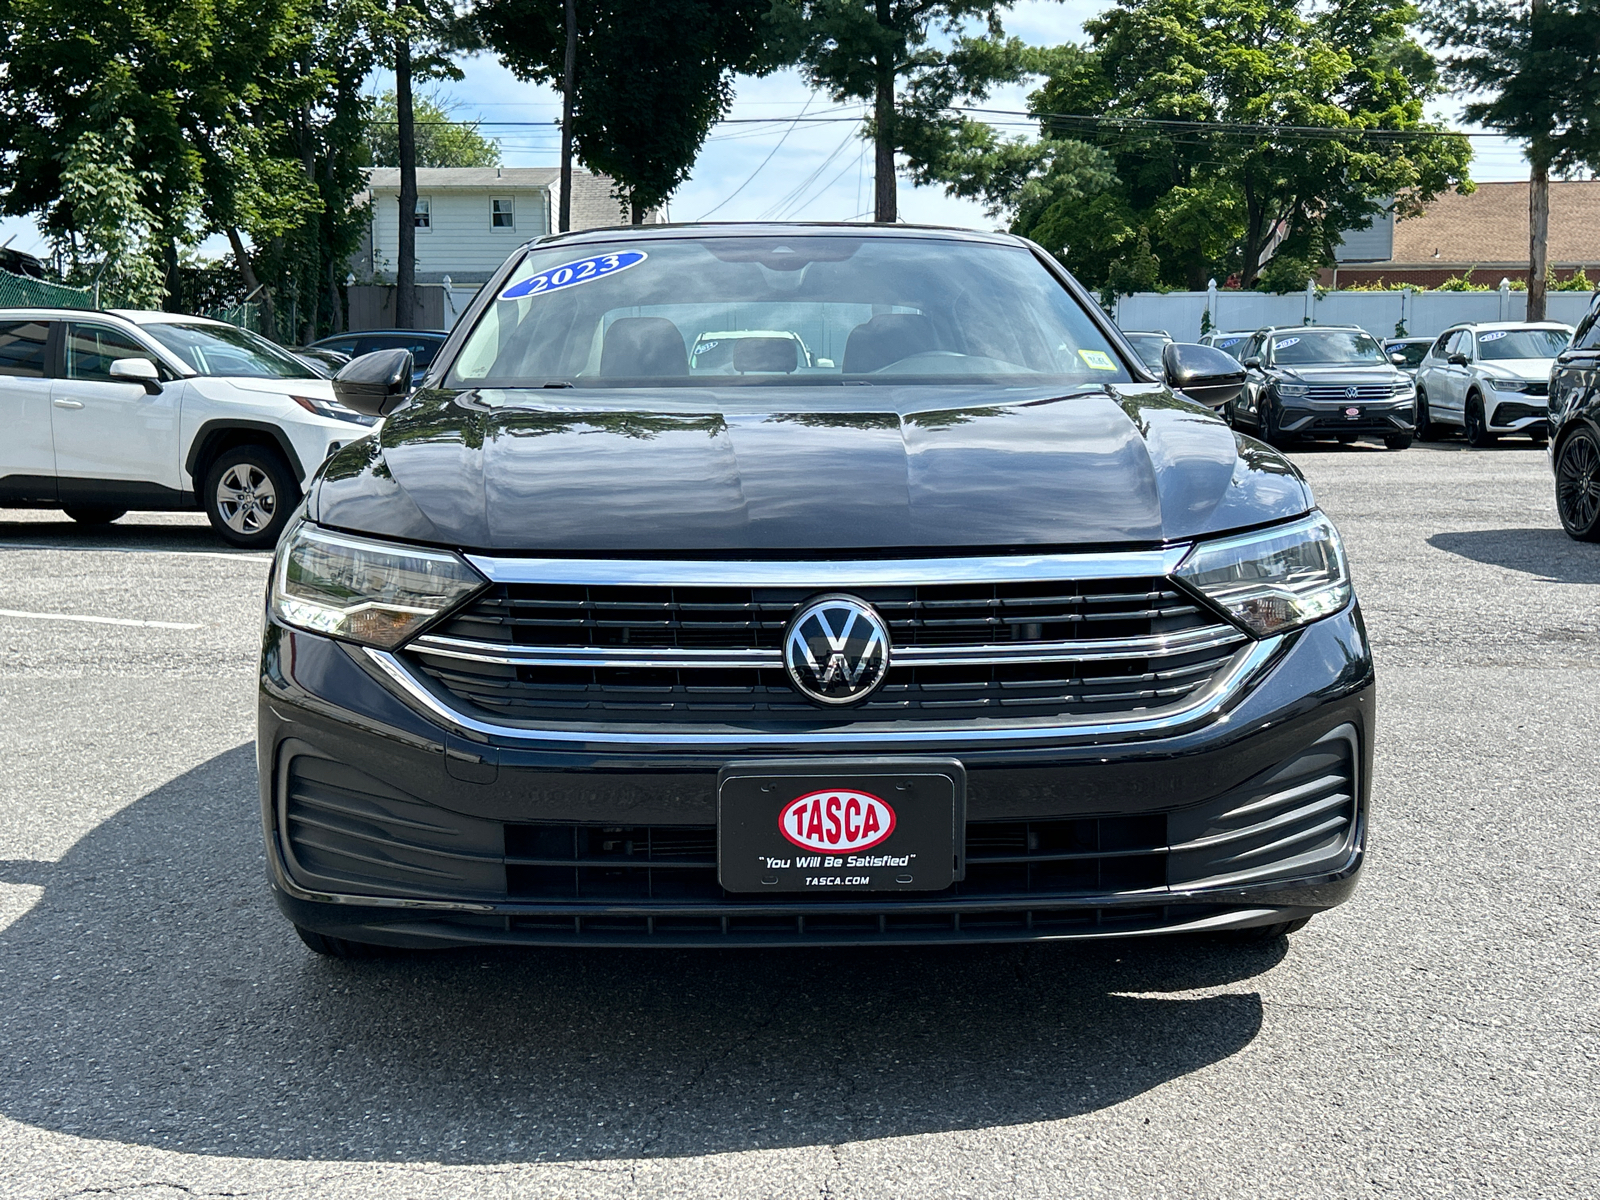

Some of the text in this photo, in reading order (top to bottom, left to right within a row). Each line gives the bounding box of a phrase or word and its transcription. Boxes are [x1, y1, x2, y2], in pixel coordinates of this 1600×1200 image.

[528, 255, 619, 294] 2023
[788, 603, 886, 697] VW
[792, 796, 880, 845] TASCA
[758, 854, 917, 869] "You Will Be Satisfied"
[805, 876, 870, 886] TASCA.COM
